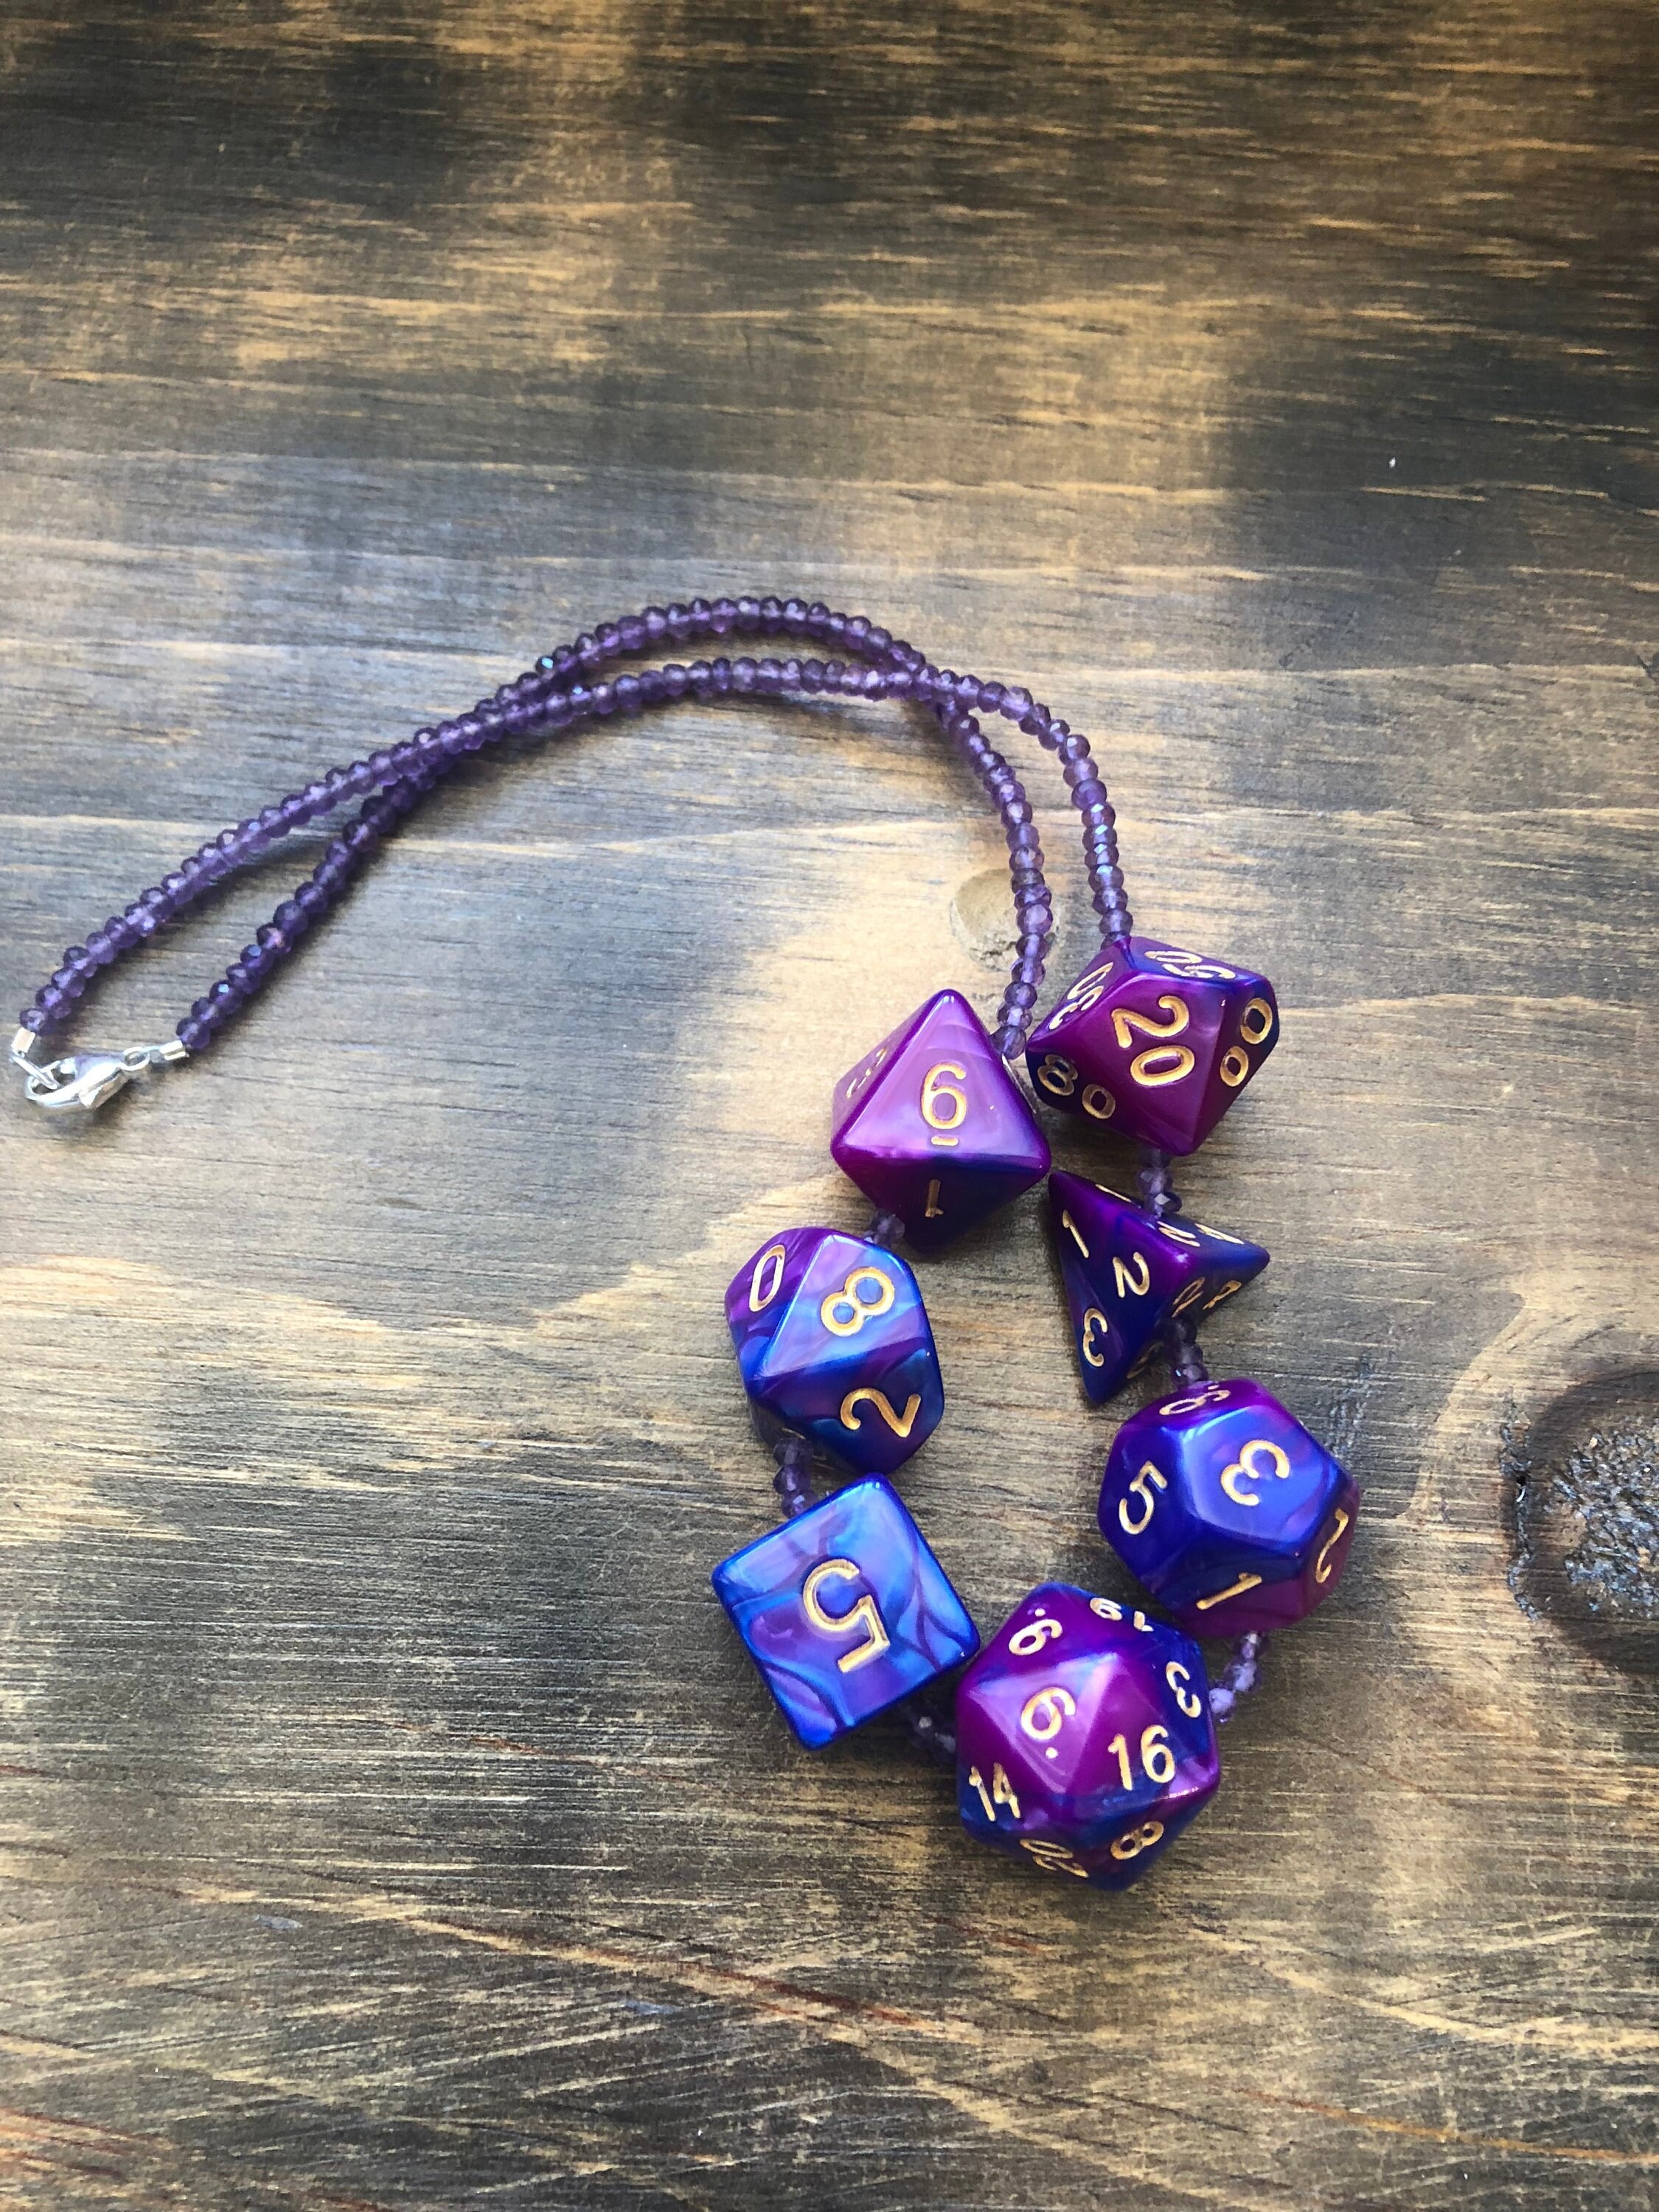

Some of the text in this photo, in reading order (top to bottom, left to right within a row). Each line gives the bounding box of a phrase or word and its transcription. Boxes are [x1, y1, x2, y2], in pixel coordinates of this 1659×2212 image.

[1110, 995, 1196, 1087] 20
[1220, 997, 1273, 1087] 00
[1037, 1054, 1116, 1119] 80
[925, 1179, 944, 1217] 1
[1062, 1209, 1090, 1258] 1
[749, 1245, 786, 1312] 0
[821, 1267, 894, 1337] 8
[1112, 1251, 1150, 1298] 2
[1082, 1308, 1108, 1367] 3
[840, 1387, 922, 1438] 2
[1119, 1461, 1168, 1535] 5
[1221, 1440, 1290, 1506] 3
[1315, 1509, 1349, 1583] 2
[802, 1558, 891, 1673] 5
[1197, 1572, 1263, 1610] 1
[1166, 1661, 1201, 1718] 3
[1107, 1724, 1175, 1791] 16
[968, 1761, 1021, 1822] 14
[1110, 1820, 1164, 1860] 8
